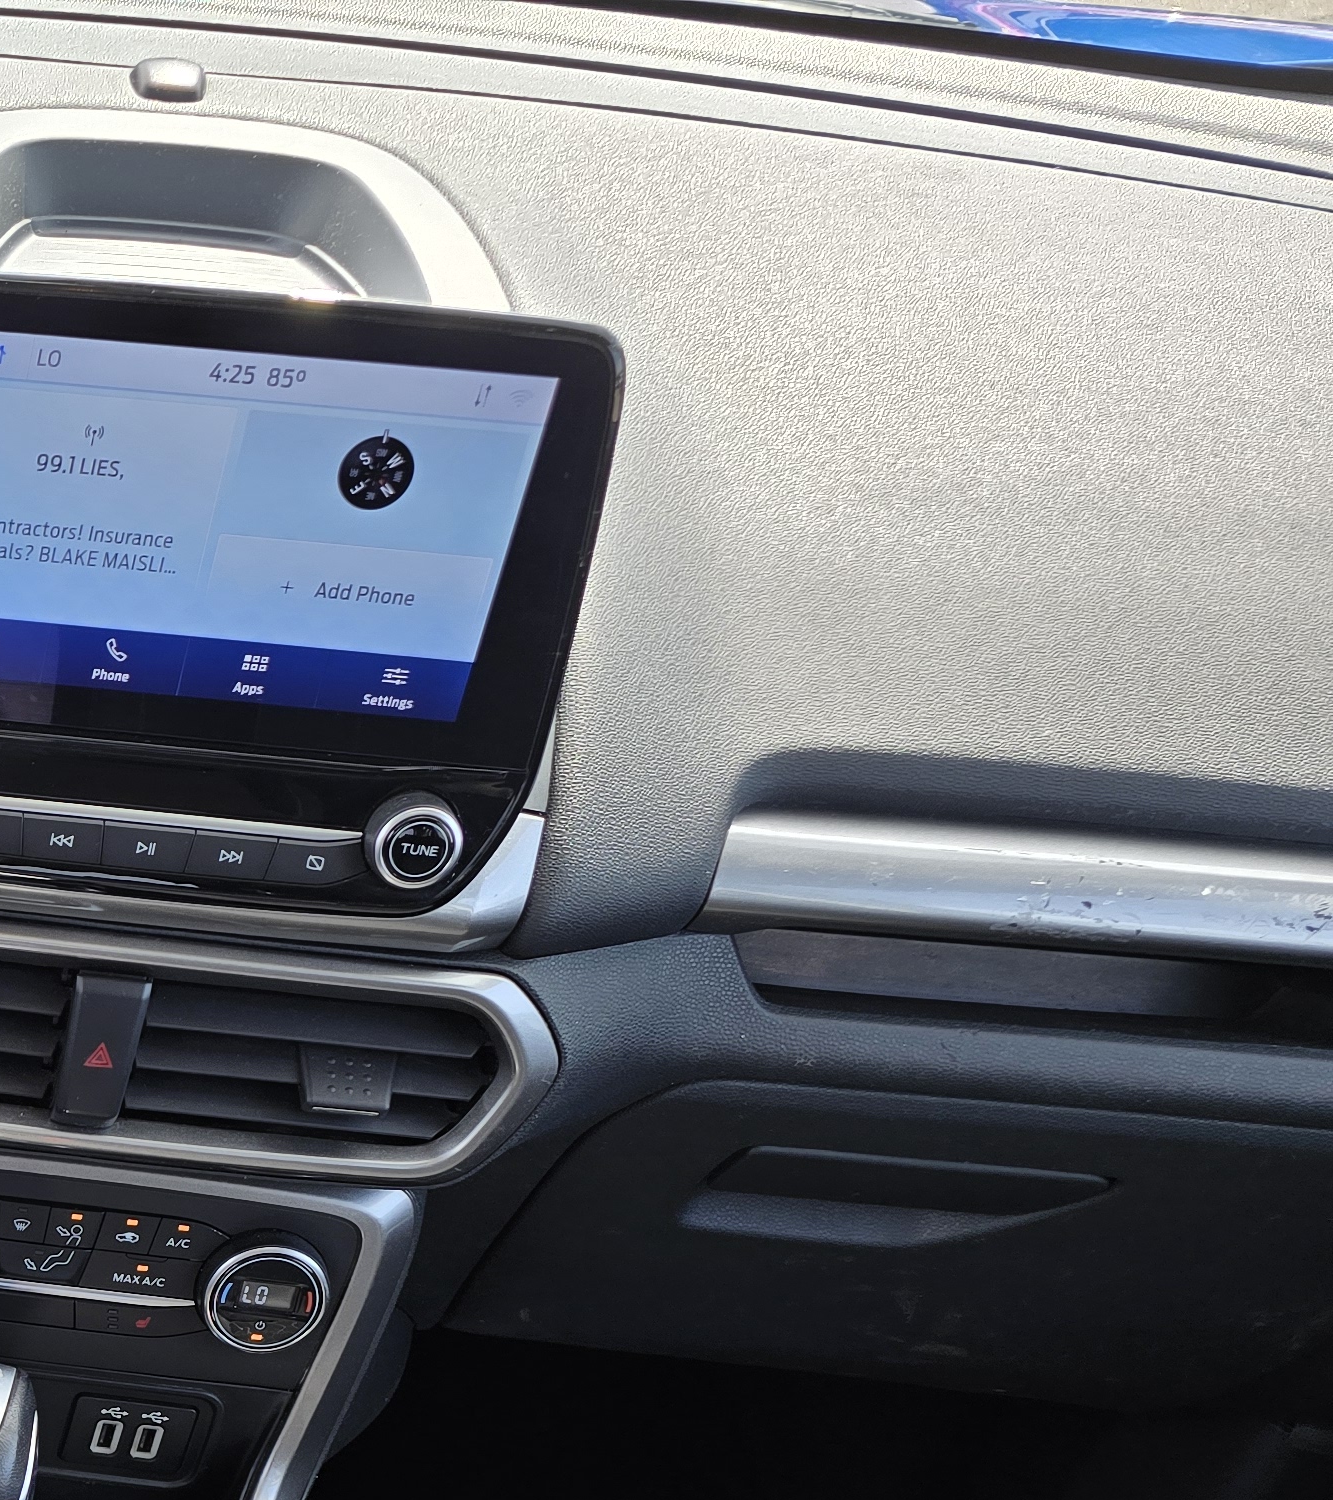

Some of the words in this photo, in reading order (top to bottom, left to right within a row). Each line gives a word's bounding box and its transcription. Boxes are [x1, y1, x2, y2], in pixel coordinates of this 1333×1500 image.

[35, 349, 62, 367] LO
[209, 362, 256, 384] 4:25
[35, 454, 77, 475] 99.1
[78, 457, 125, 480] LIES,
[359, 452, 371, 465] S
[386, 452, 406, 468] W
[349, 481, 365, 494] E
[379, 482, 395, 497] N
[88, 524, 174, 549] Insurance
[38, 545, 99, 568] BLAKE
[314, 580, 352, 602] Add
[355, 585, 415, 607] Phone
[91, 667, 130, 683] Phone
[232, 680, 264, 697] Apps
[361, 692, 414, 711] Settings
[401, 842, 439, 857] TUNE
[166, 1236, 190, 1250] A/C
[112, 1271, 140, 1285] MAX
[142, 1274, 166, 1288] A/C
[239, 1284, 270, 1304] LO
